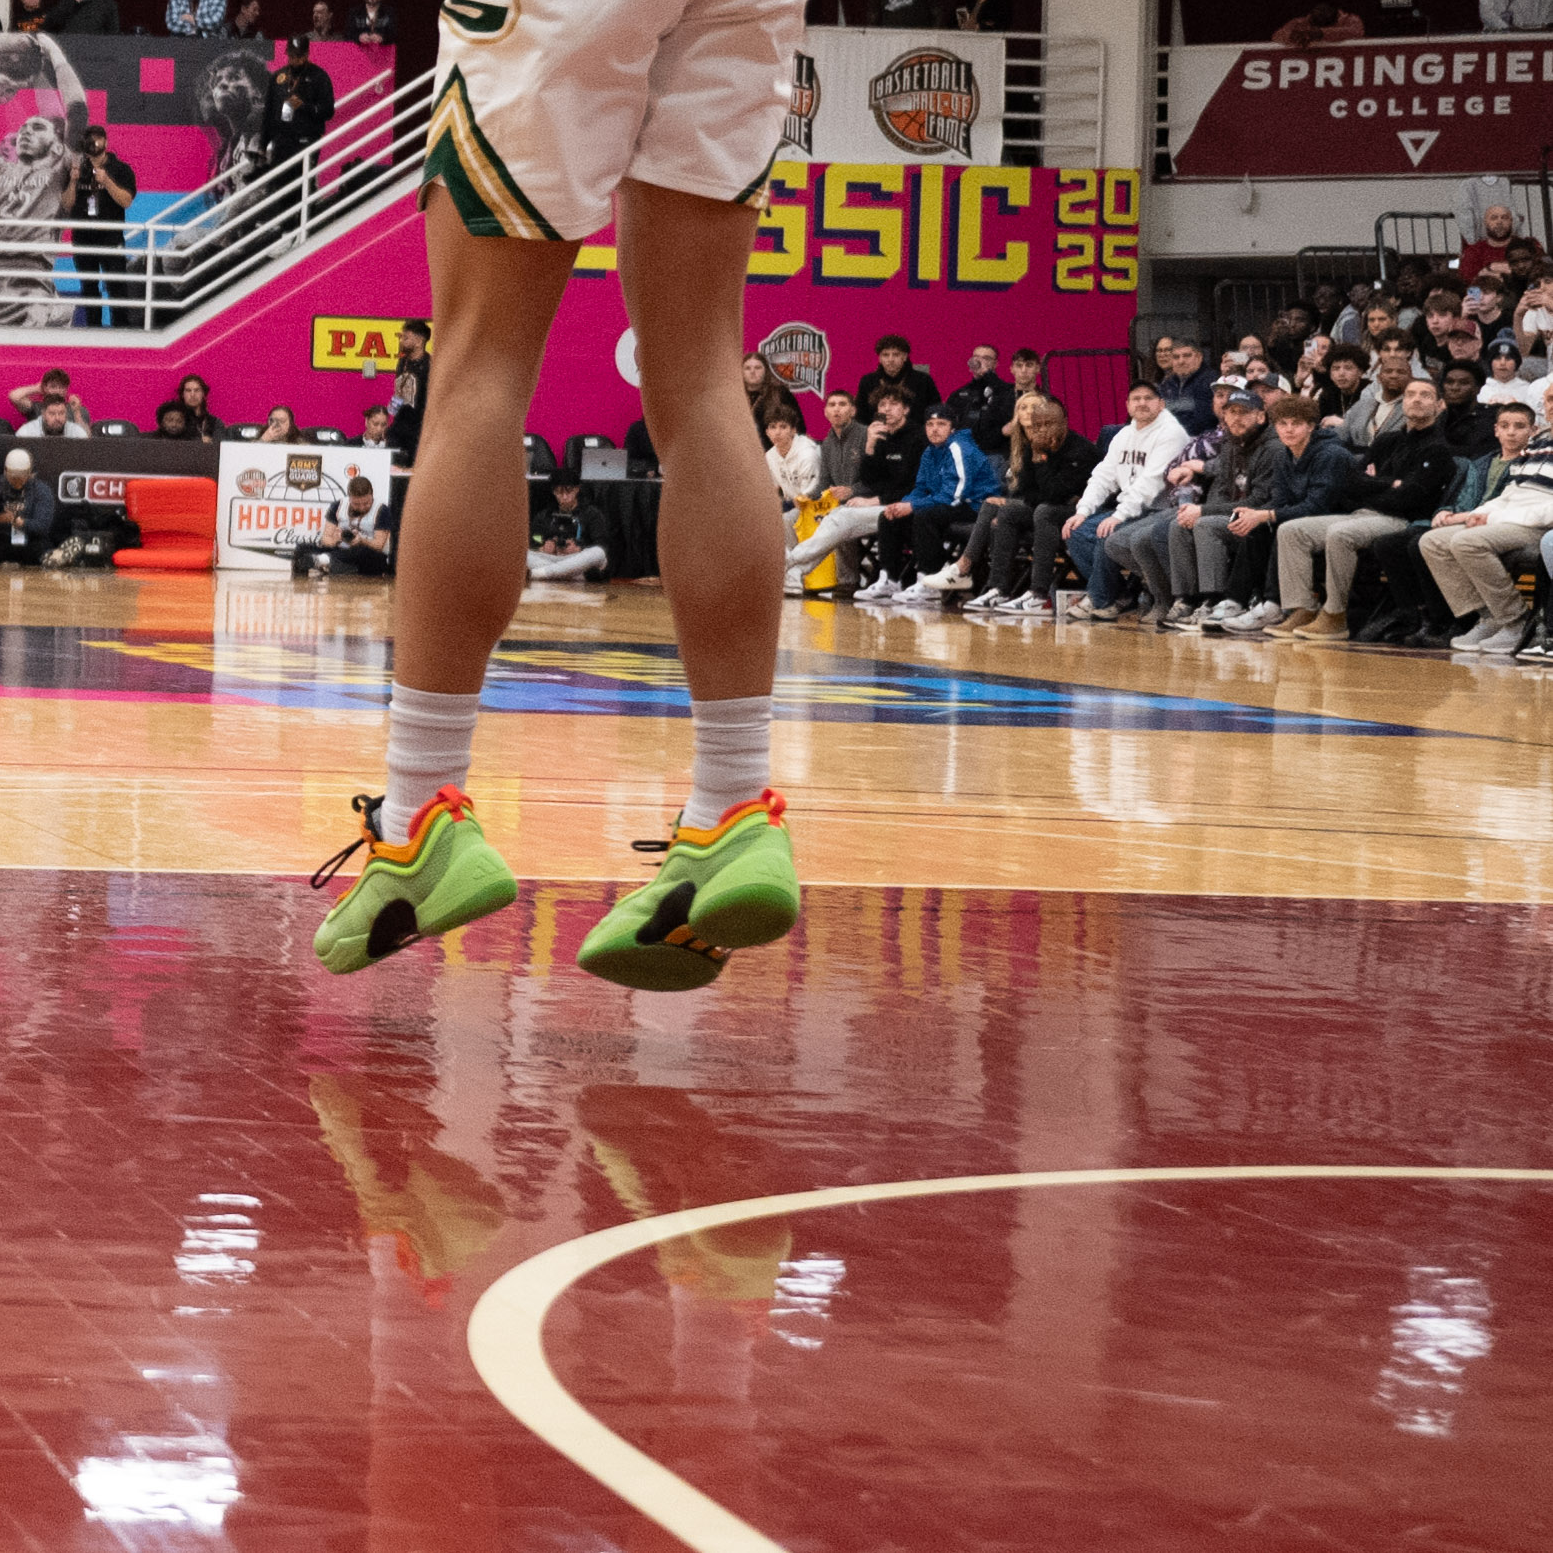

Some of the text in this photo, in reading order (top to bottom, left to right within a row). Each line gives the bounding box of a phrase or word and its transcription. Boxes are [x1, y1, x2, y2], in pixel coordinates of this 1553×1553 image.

[876, 61, 968, 99] BASKETBALL
[1329, 95, 1512, 119] COLLEGE
[929, 115, 968, 154] FAME
[1056, 168, 1140, 226] 20
[1055, 232, 1139, 293] 25
[290, 459, 319, 469] ARMY
